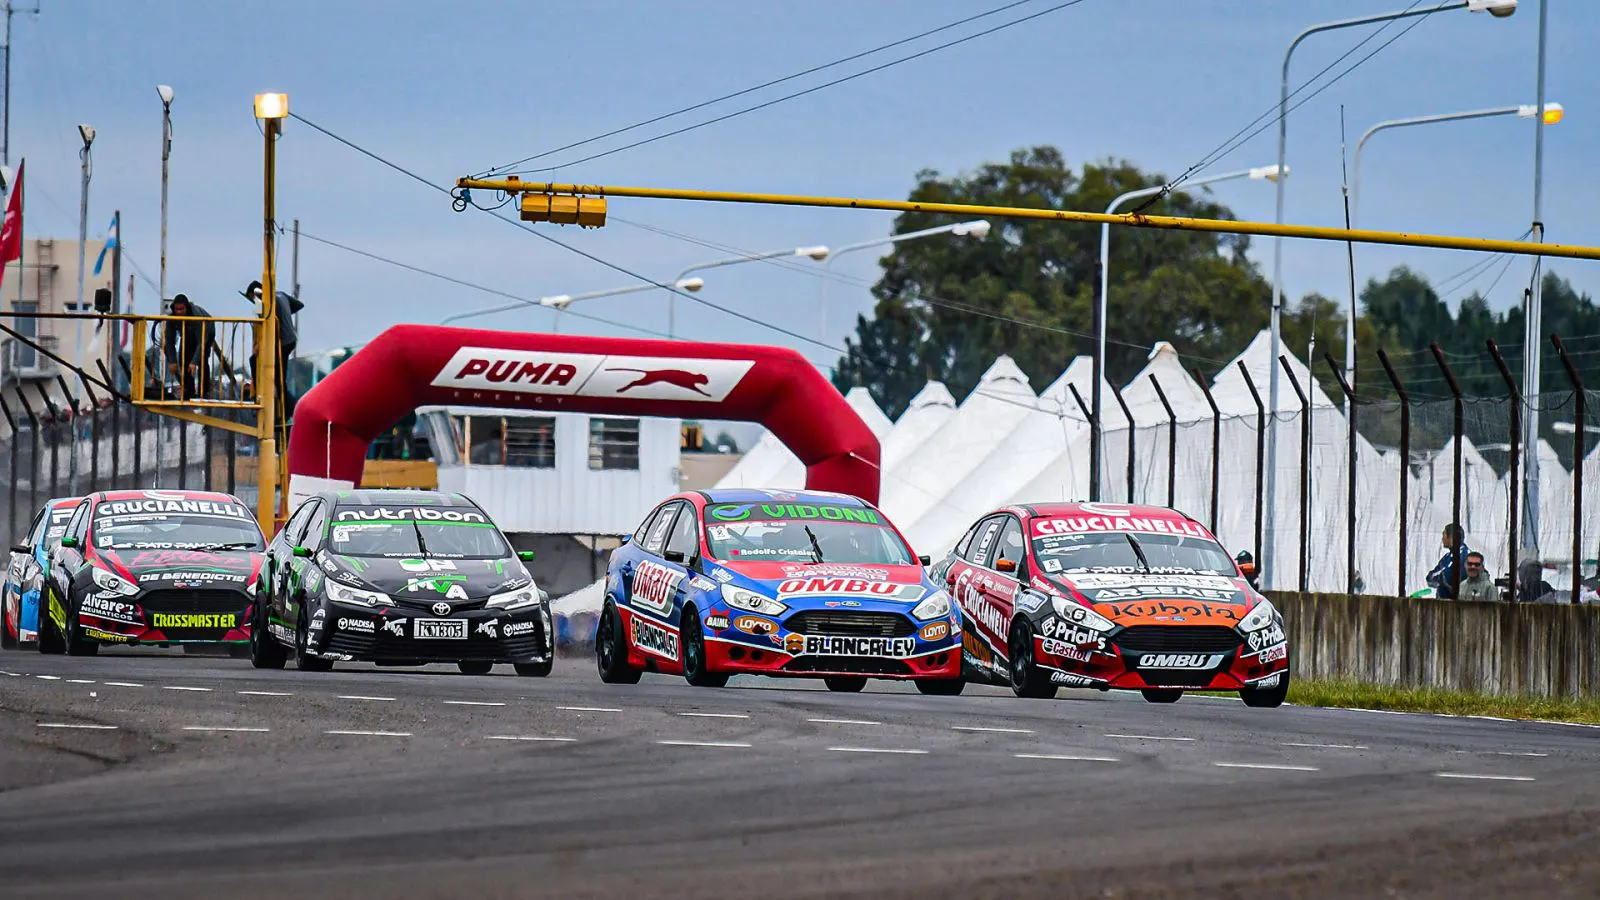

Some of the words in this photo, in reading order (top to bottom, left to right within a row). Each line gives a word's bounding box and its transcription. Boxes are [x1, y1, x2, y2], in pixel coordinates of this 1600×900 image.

[454, 358, 577, 386] PUMA
[453, 390, 564, 404] ENERGY
[98, 500, 245, 518] CRUCIANELLI
[338, 507, 485, 522] nutribon
[761, 504, 878, 524] VIDONI
[1036, 517, 1208, 537] CRUCIANELLI
[139, 573, 160, 582] DE
[633, 561, 673, 605] OMBU
[779, 579, 898, 594] OMBU
[750, 598, 761, 606] 27
[81, 605, 133, 620] NEUMATICOS
[1074, 609, 1086, 619] 6
[1111, 602, 1240, 620] Kubota
[153, 613, 236, 628] CROSSMASTER
[348, 619, 375, 629] NADISA
[420, 625, 462, 637] KM305
[924, 624, 946, 638] LOYTO
[1055, 620, 1107, 650] Prialis
[807, 636, 915, 657] BLANCALEY
[1053, 642, 1089, 661] Castrol
[1140, 655, 1206, 667] OMBU
